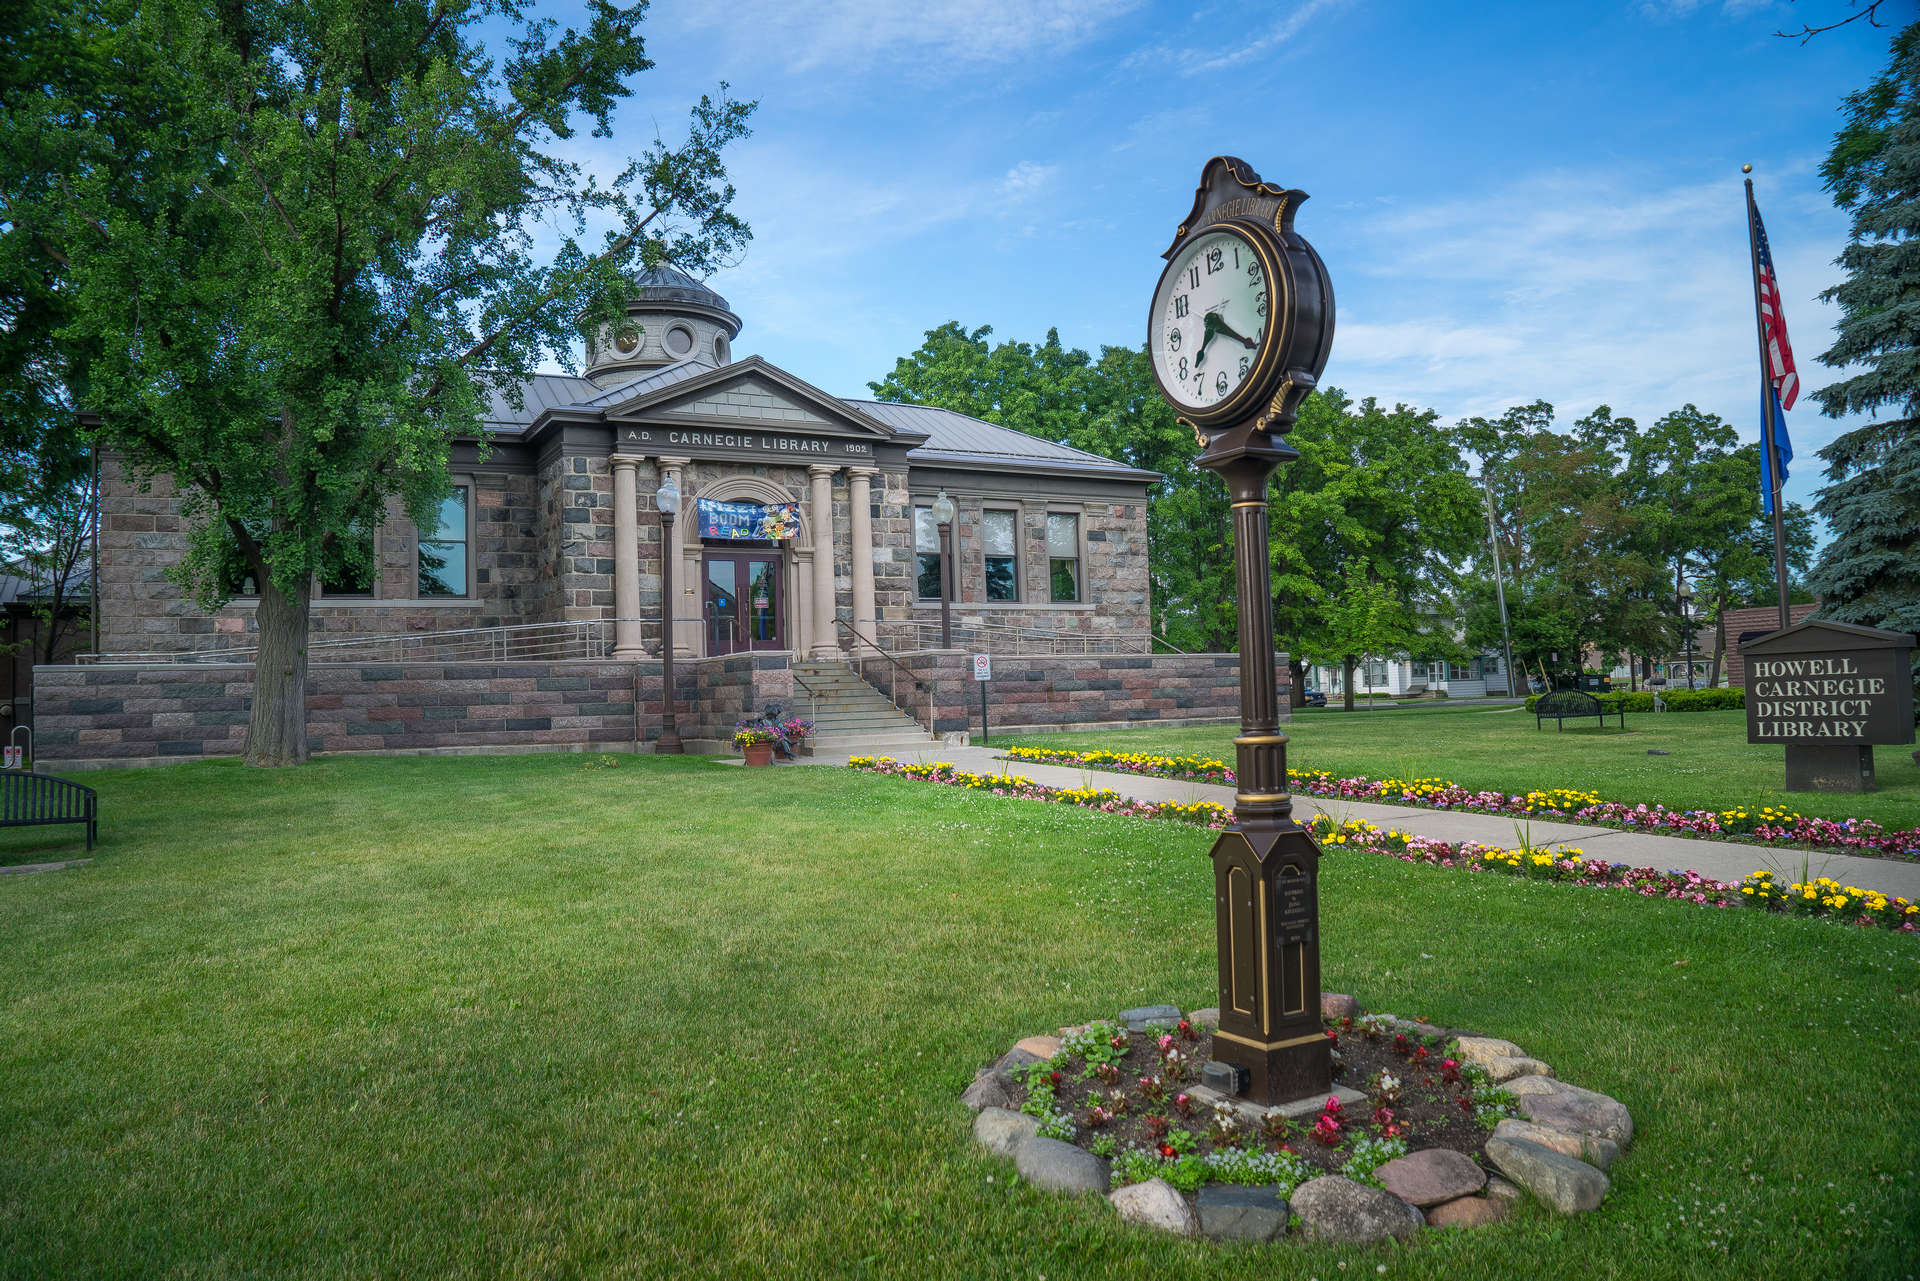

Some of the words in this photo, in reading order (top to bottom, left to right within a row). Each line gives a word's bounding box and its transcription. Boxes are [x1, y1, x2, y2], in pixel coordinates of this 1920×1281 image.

[1241, 198, 1275, 219] LIBRARY
[1207, 247, 1224, 275] 12
[1248, 261, 1261, 288] 2
[1170, 327, 1181, 352] 9
[1179, 356, 1188, 381] 8
[1193, 372, 1205, 396] 7
[1216, 371, 1228, 397] 6
[628, 431, 652, 441] A.D.
[669, 432, 753, 448] CARNEGIE
[762, 437, 829, 452] LIBRARY
[845, 444, 868, 453] 1902
[709, 512, 750, 526] BOOM
[709, 526, 750, 539] READ
[1753, 658, 1858, 678] HOWELL
[1755, 678, 1885, 697] CARNEGIE
[1757, 699, 1872, 717] DISTRICT
[1757, 720, 1866, 737] LIBRARY
